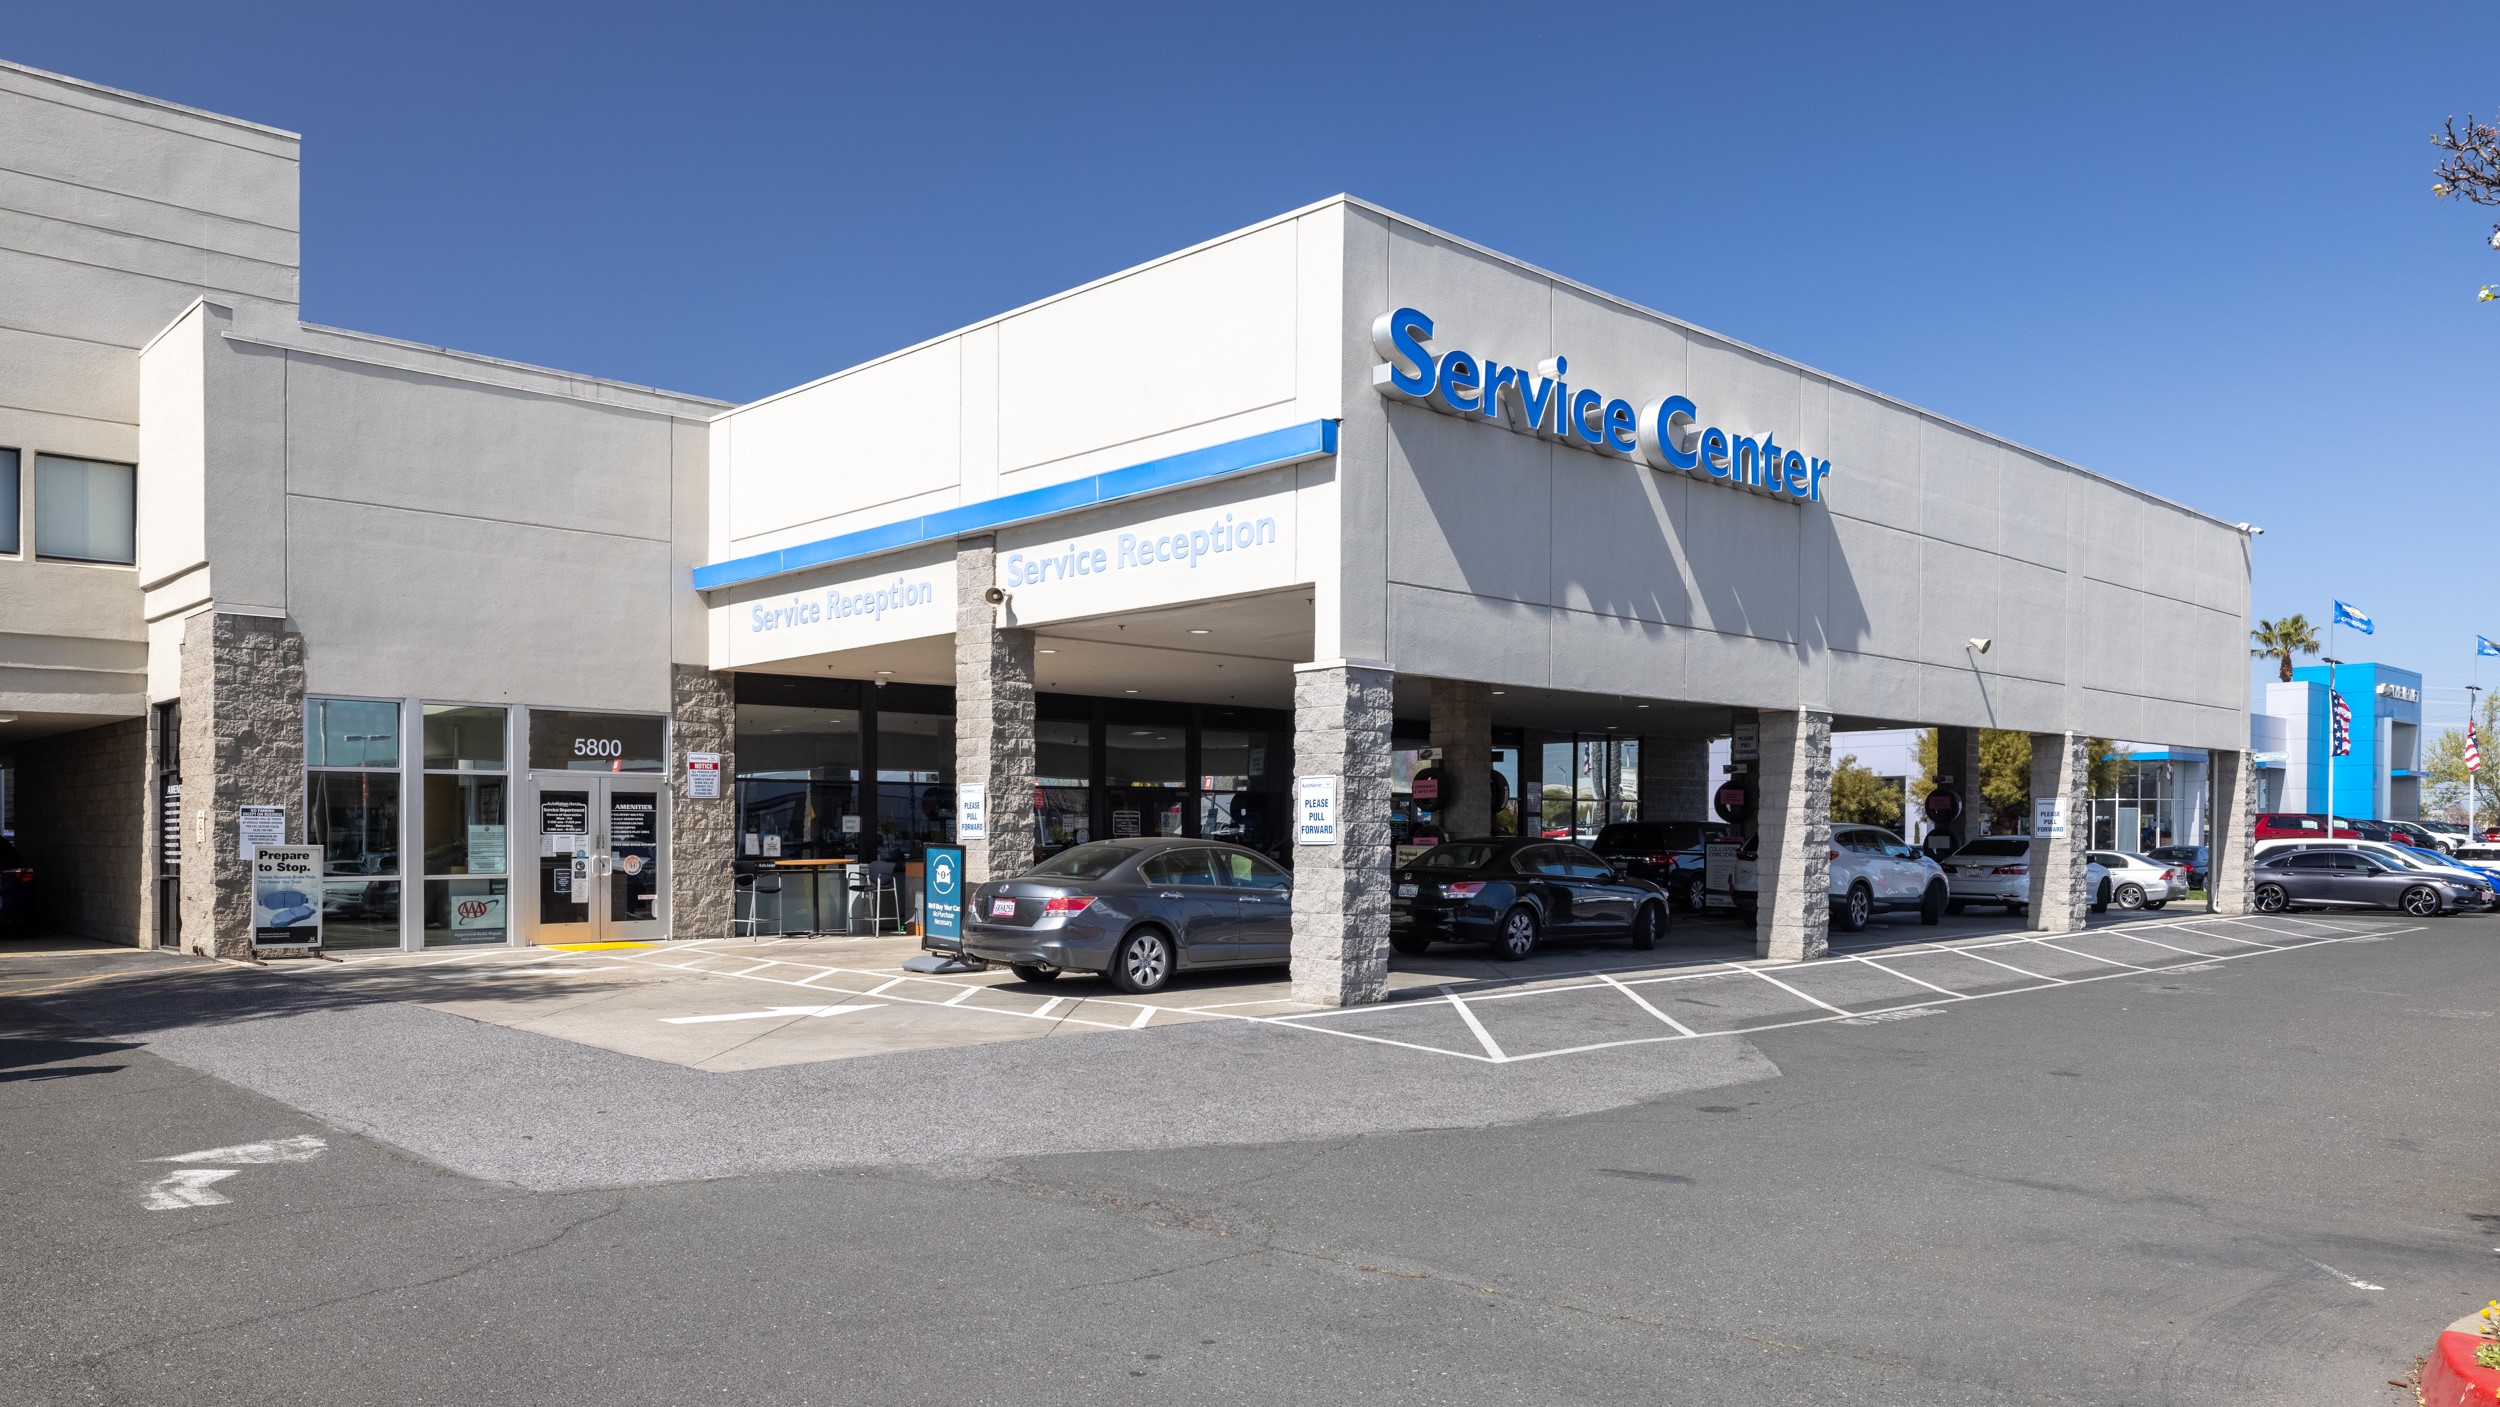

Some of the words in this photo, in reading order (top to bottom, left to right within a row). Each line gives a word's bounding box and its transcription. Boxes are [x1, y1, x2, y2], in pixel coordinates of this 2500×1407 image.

[1391, 307, 1638, 454] Service
[1656, 394, 1832, 503] Center
[1007, 543, 1107, 588] Service
[1117, 512, 1276, 569] Reception
[752, 597, 820, 632] Service
[826, 577, 932, 621] Reception
[574, 738, 622, 757] 5800
[964, 802, 980, 810] PLEASE
[1305, 799, 1329, 808] PLEASE
[1309, 812, 1325, 821] PULL
[962, 823, 983, 831] FORWARD
[1301, 825, 1333, 834] FORWARD
[259, 850, 310, 861] Prepare
[259, 863, 272, 871] to
[277, 862, 311, 873] Stop.
[462, 902, 484, 918] AAA
[935, 903, 943, 911] Buy
